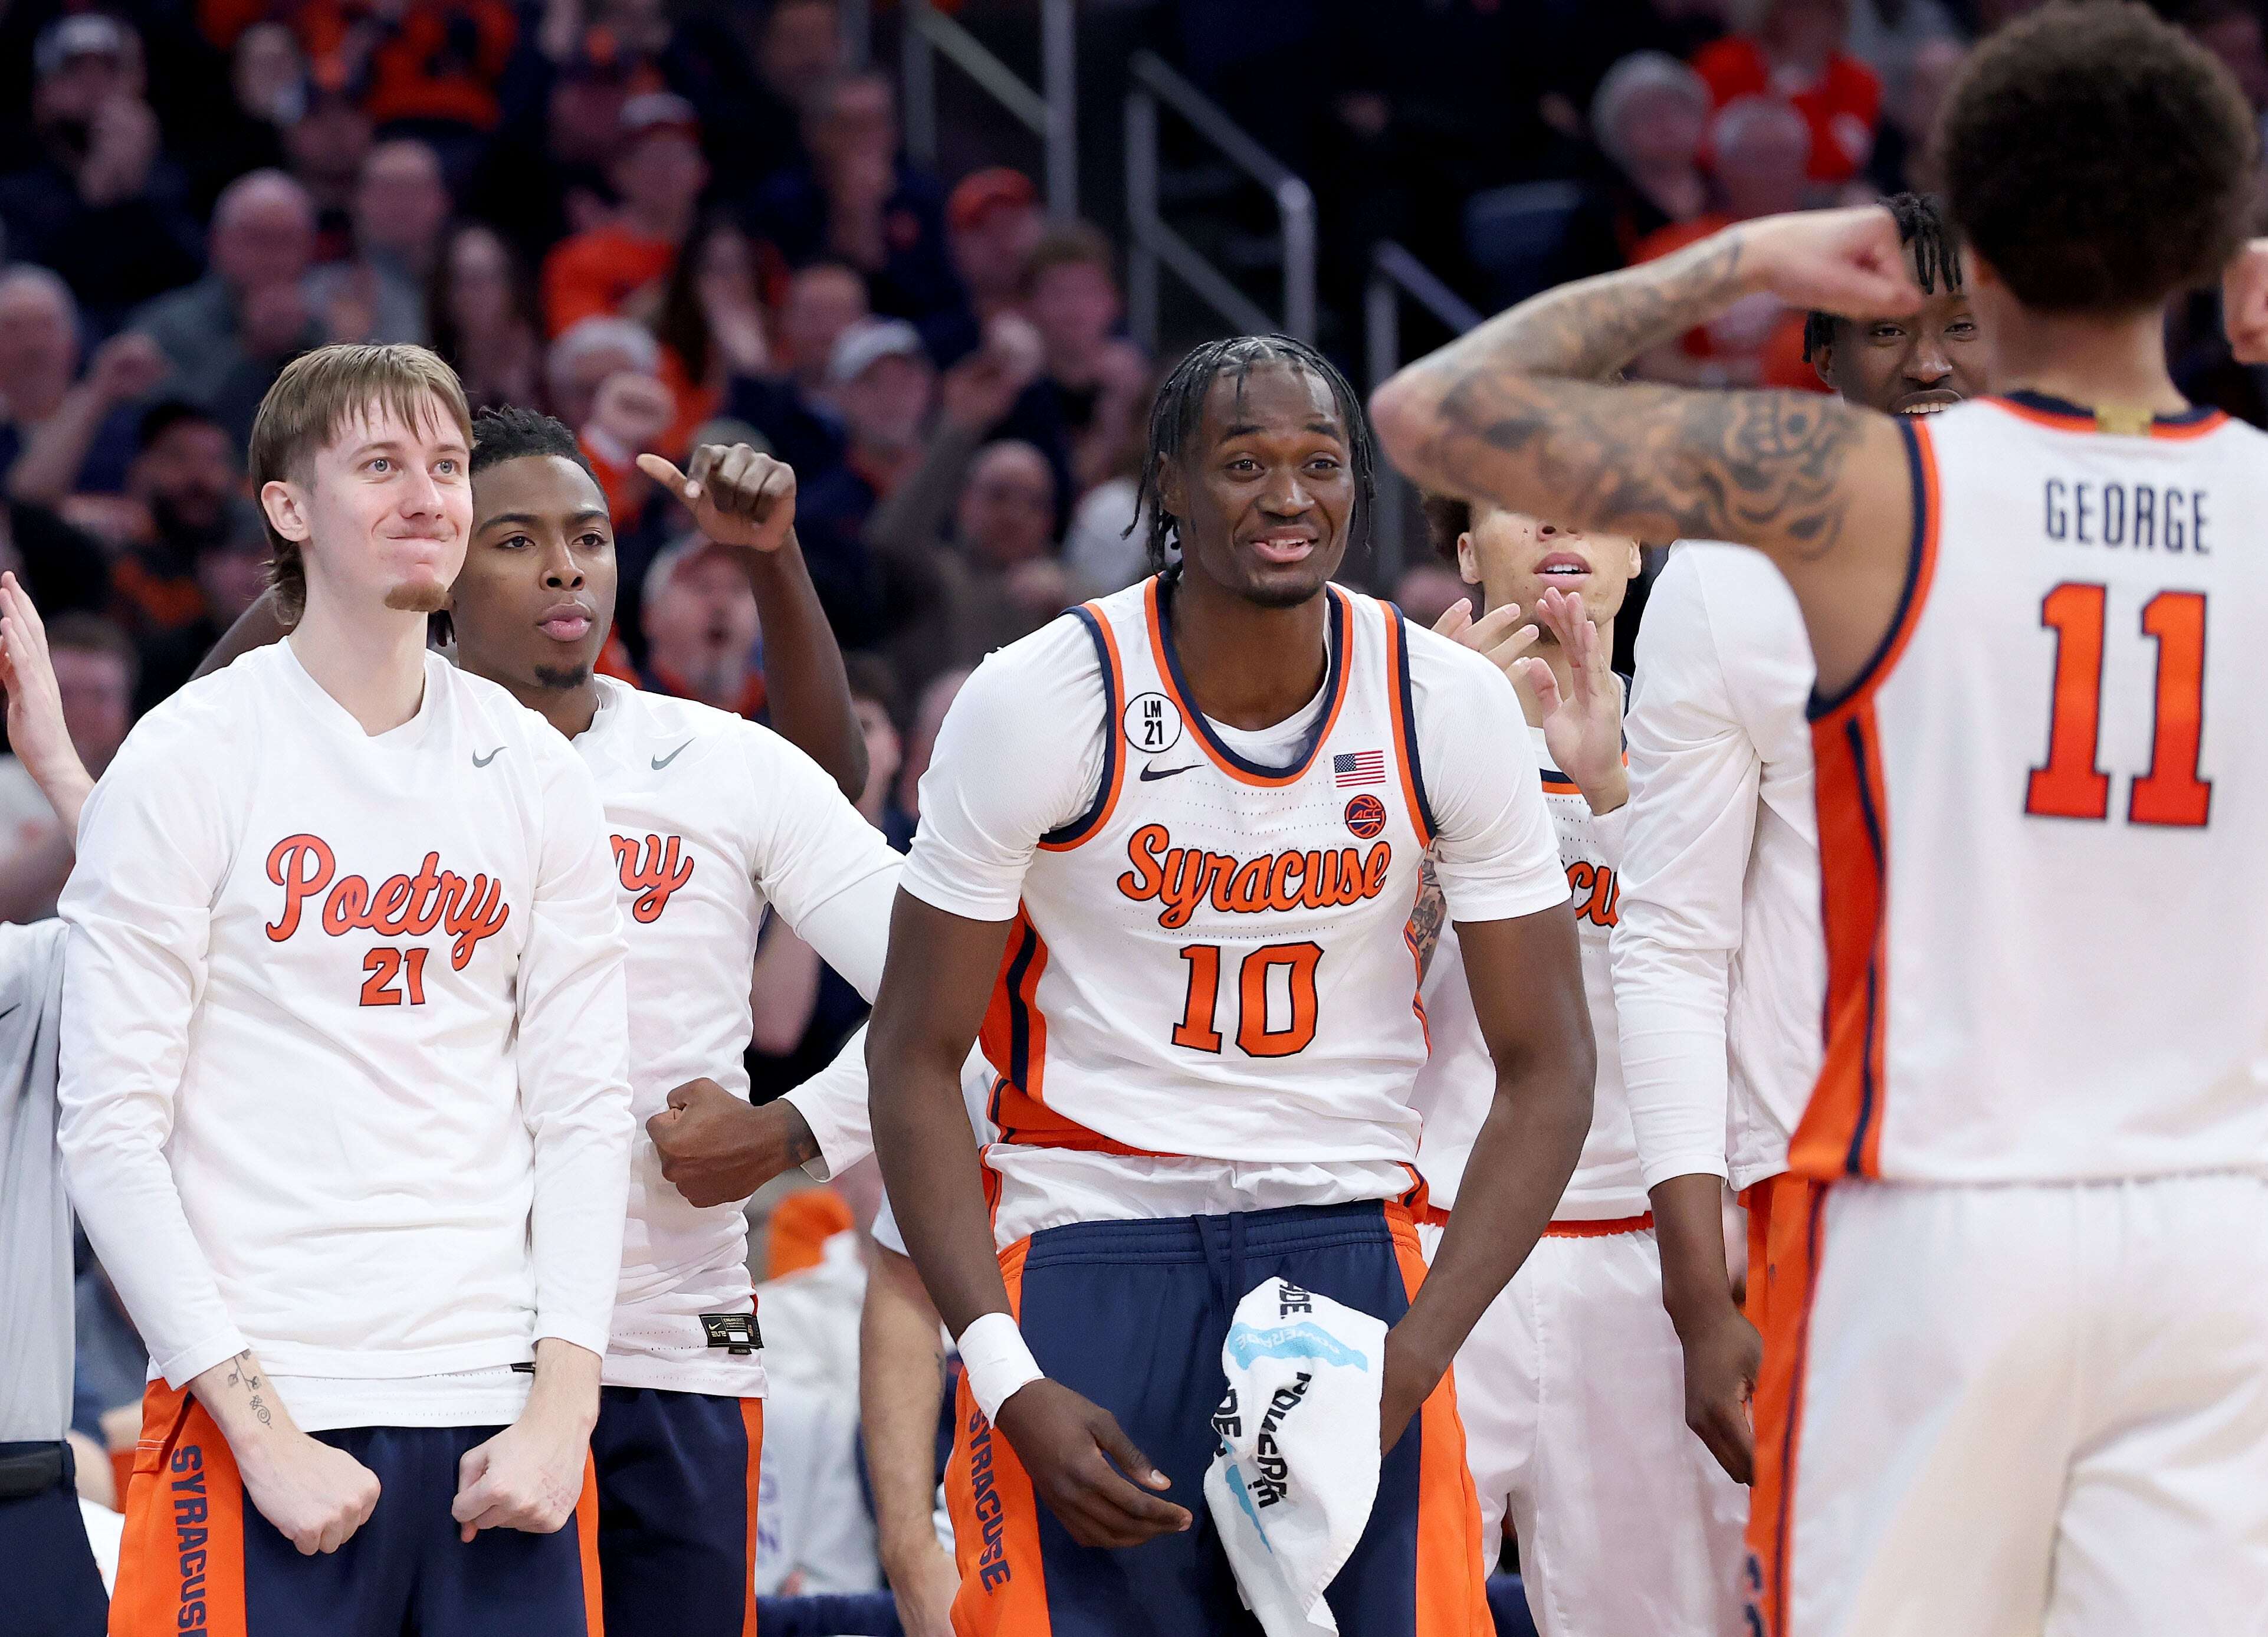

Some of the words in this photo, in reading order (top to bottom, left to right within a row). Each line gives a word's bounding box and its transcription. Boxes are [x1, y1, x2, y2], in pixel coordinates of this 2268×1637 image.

[2044, 478, 2211, 555] GEORGE
[1144, 700, 1161, 718] LM
[1144, 720, 1163, 745] 21
[2024, 580, 2212, 827] 11
[1351, 808, 1383, 819] ACC
[265, 833, 510, 972] Poetry
[1117, 823, 1391, 930] Syracuse
[359, 947, 429, 1006] 21
[1170, 940, 1325, 1058] 10
[969, 1408, 1011, 1596] SYRACUSE
